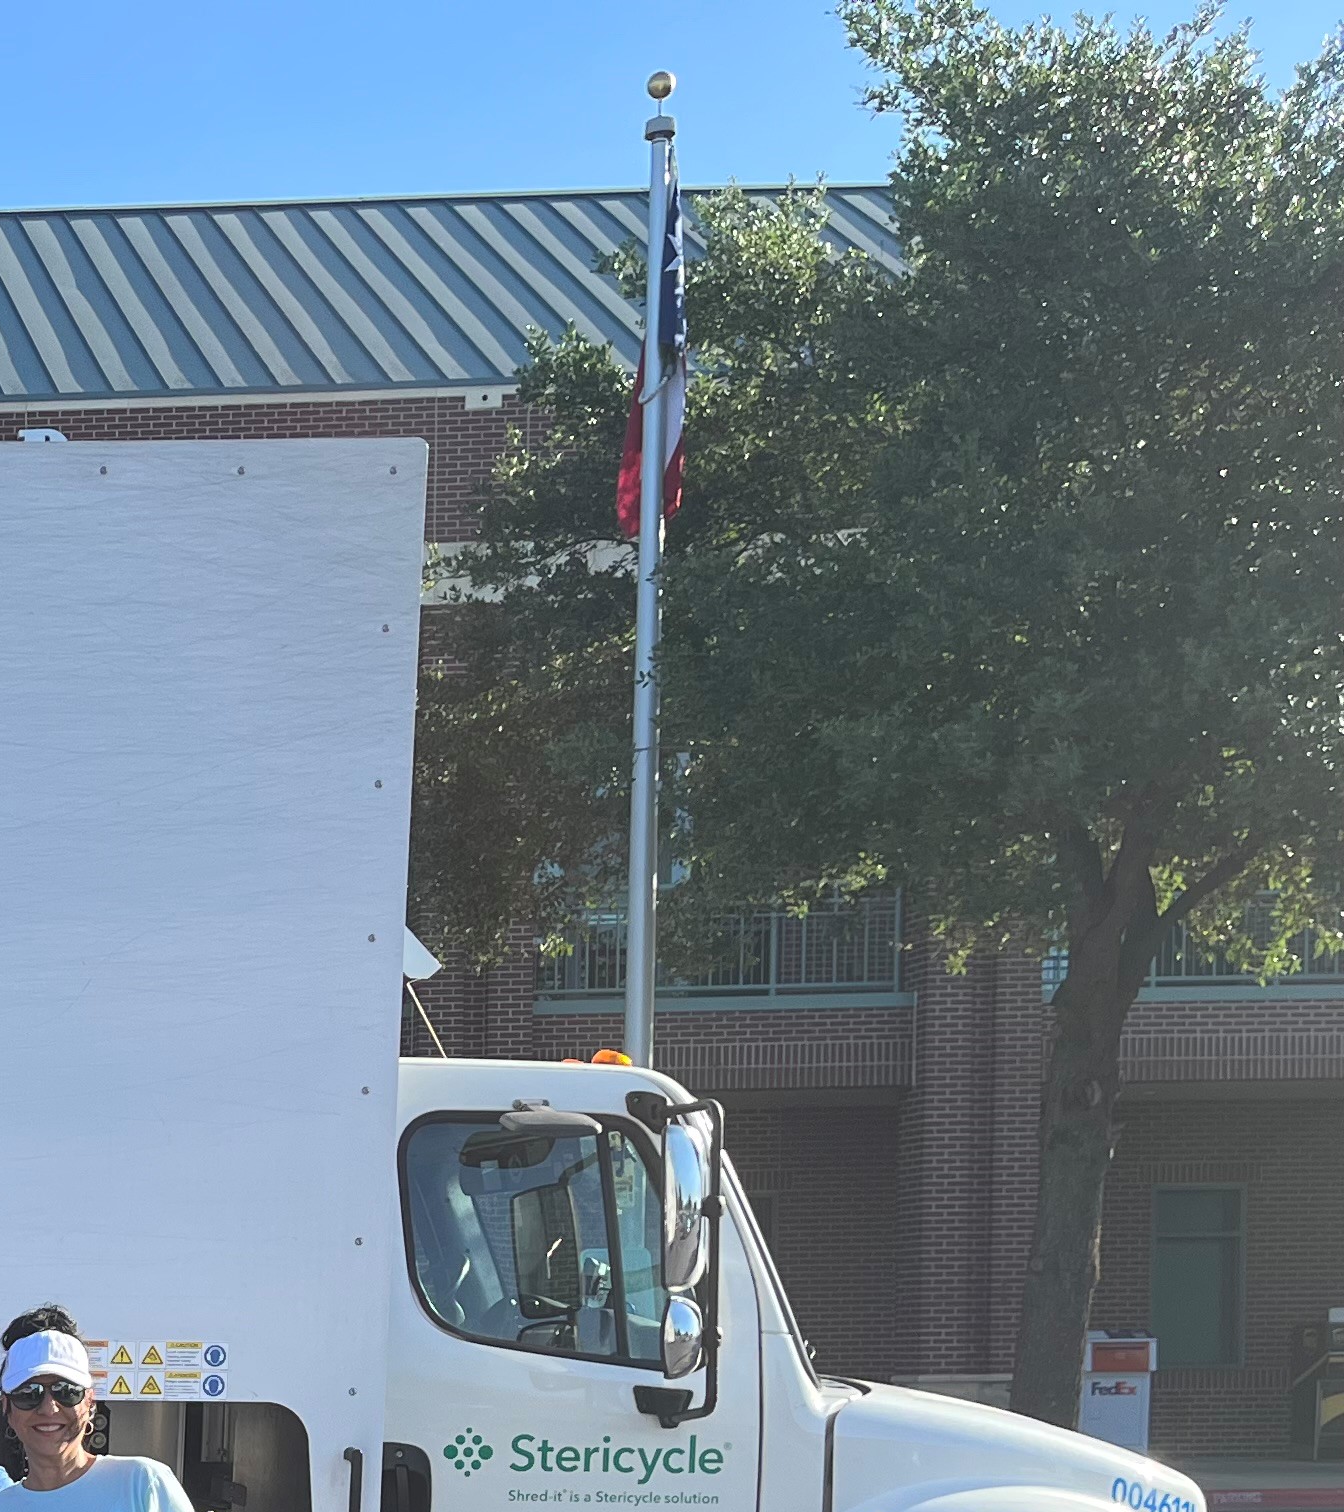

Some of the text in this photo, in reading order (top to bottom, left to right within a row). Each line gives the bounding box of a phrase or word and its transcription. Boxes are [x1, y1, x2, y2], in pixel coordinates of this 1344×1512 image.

[1091, 1381, 1136, 1396] FedEx
[570, 1490, 579, 1502] is
[584, 1494, 591, 1502] a
[596, 1491, 660, 1506] Stericycle
[664, 1492, 719, 1504] solution
